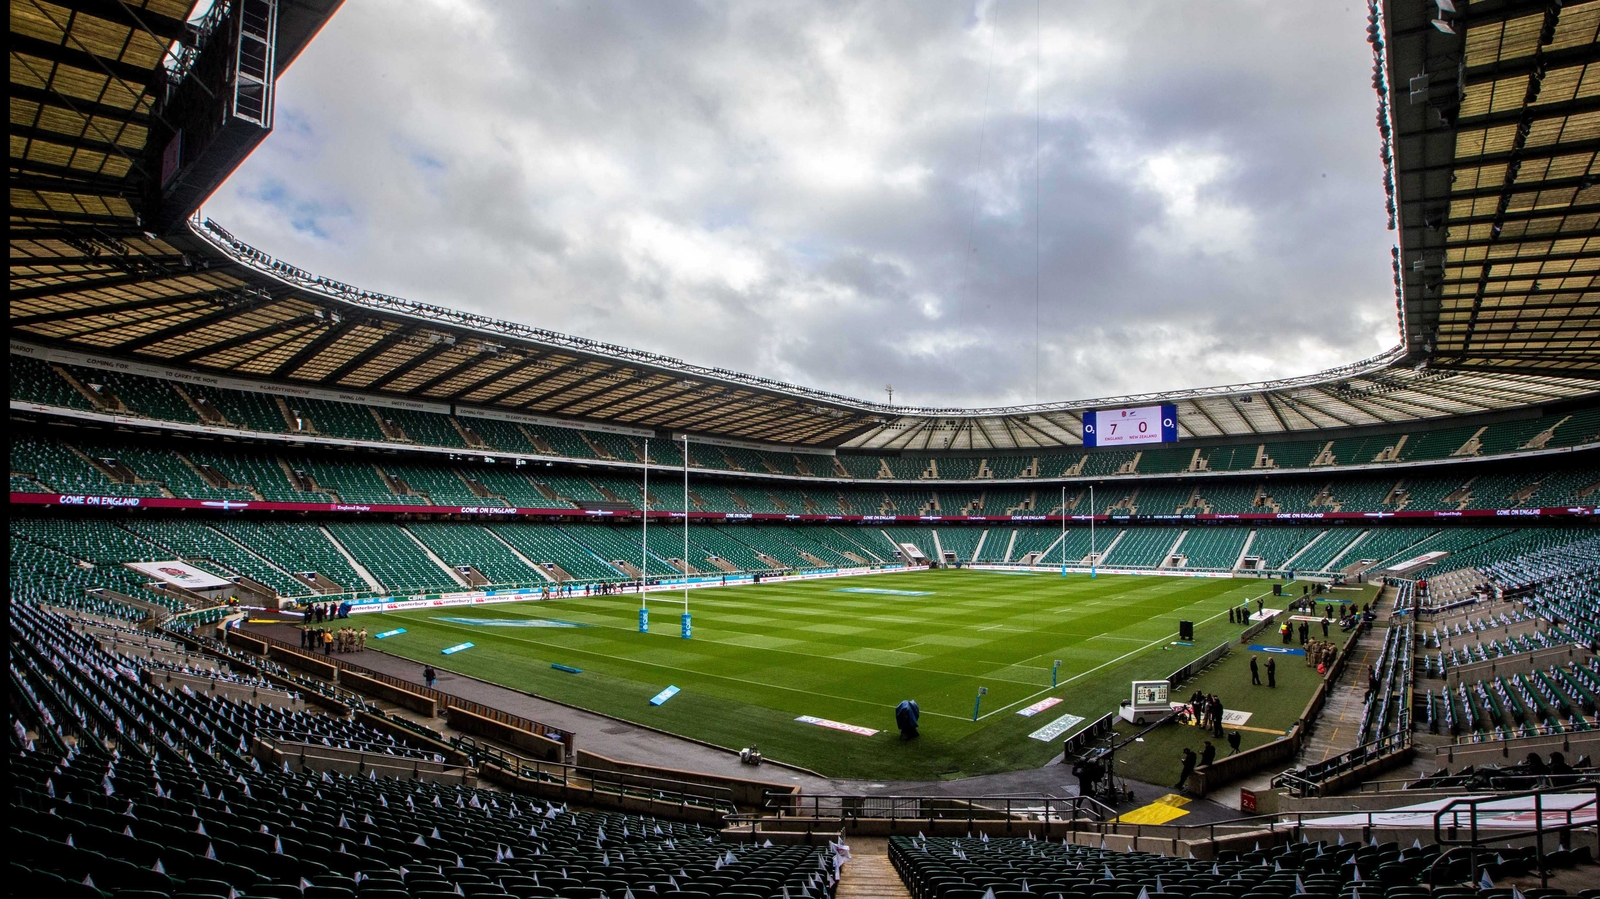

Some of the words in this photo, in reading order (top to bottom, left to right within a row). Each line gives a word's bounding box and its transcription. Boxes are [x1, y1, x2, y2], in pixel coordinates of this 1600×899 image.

[86, 358, 114, 368] COMING
[339, 394, 355, 402] SWING
[1110, 423, 1118, 435] 7
[1138, 421, 1147, 433] 0
[1163, 418, 1175, 428] O2
[1085, 424, 1095, 434] O2
[59, 495, 85, 504] COME
[87, 496, 100, 505] ON
[101, 497, 140, 507] ENGLAND
[817, 720, 877, 736] SPORTS
[1243, 799, 1248, 807] 2
